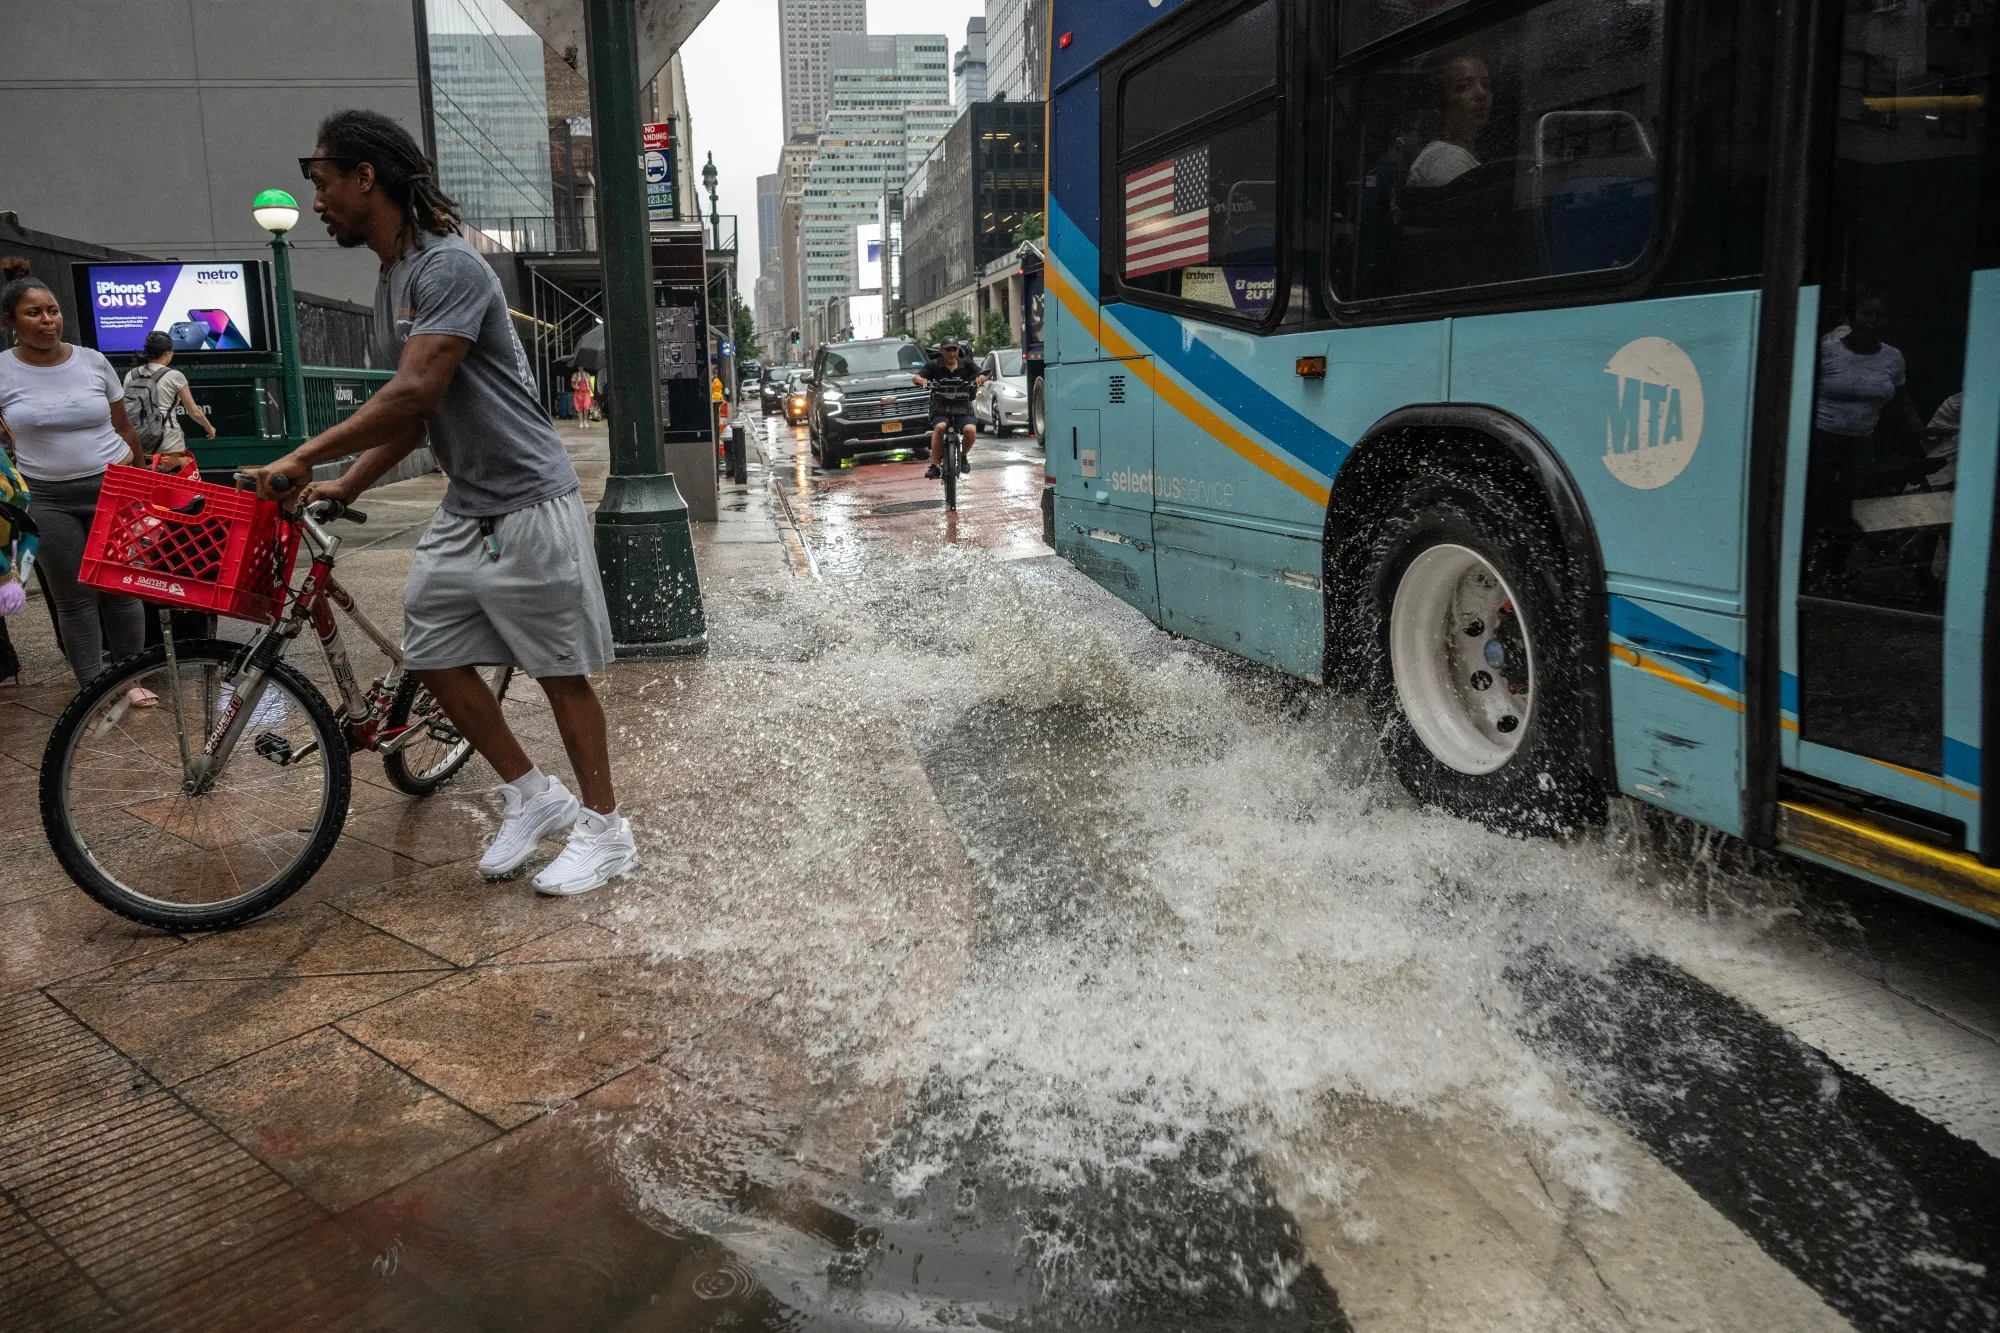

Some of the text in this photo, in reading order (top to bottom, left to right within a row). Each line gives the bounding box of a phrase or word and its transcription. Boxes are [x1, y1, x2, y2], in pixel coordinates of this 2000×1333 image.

[644, 133, 667, 141] ANDING
[197, 269, 238, 279] metro
[96, 280, 161, 294] iPhone 13
[98, 294, 147, 307] ON US
[205, 704, 235, 751] POWER
